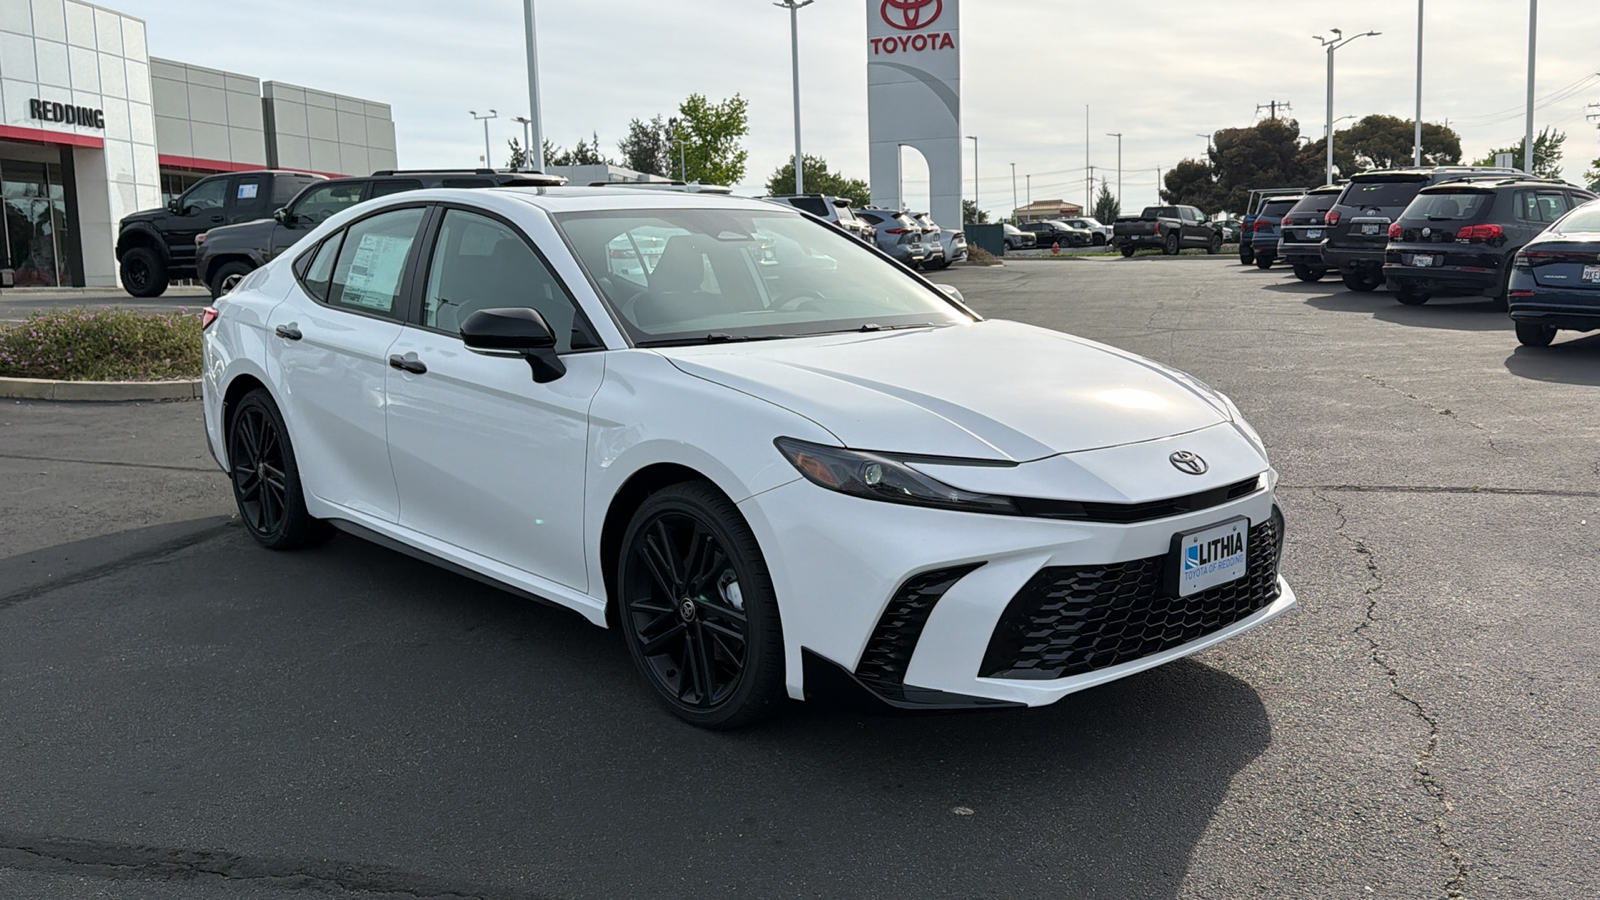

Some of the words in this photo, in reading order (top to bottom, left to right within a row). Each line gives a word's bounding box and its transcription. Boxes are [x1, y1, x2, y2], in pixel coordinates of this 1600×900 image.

[870, 32, 955, 54] TOYOTA
[30, 98, 105, 129] REDDING
[1199, 532, 1243, 566] LITHIA
[1185, 567, 1208, 580] TOYOTA
[1209, 562, 1217, 573] OF
[1218, 554, 1243, 570] REDDING
